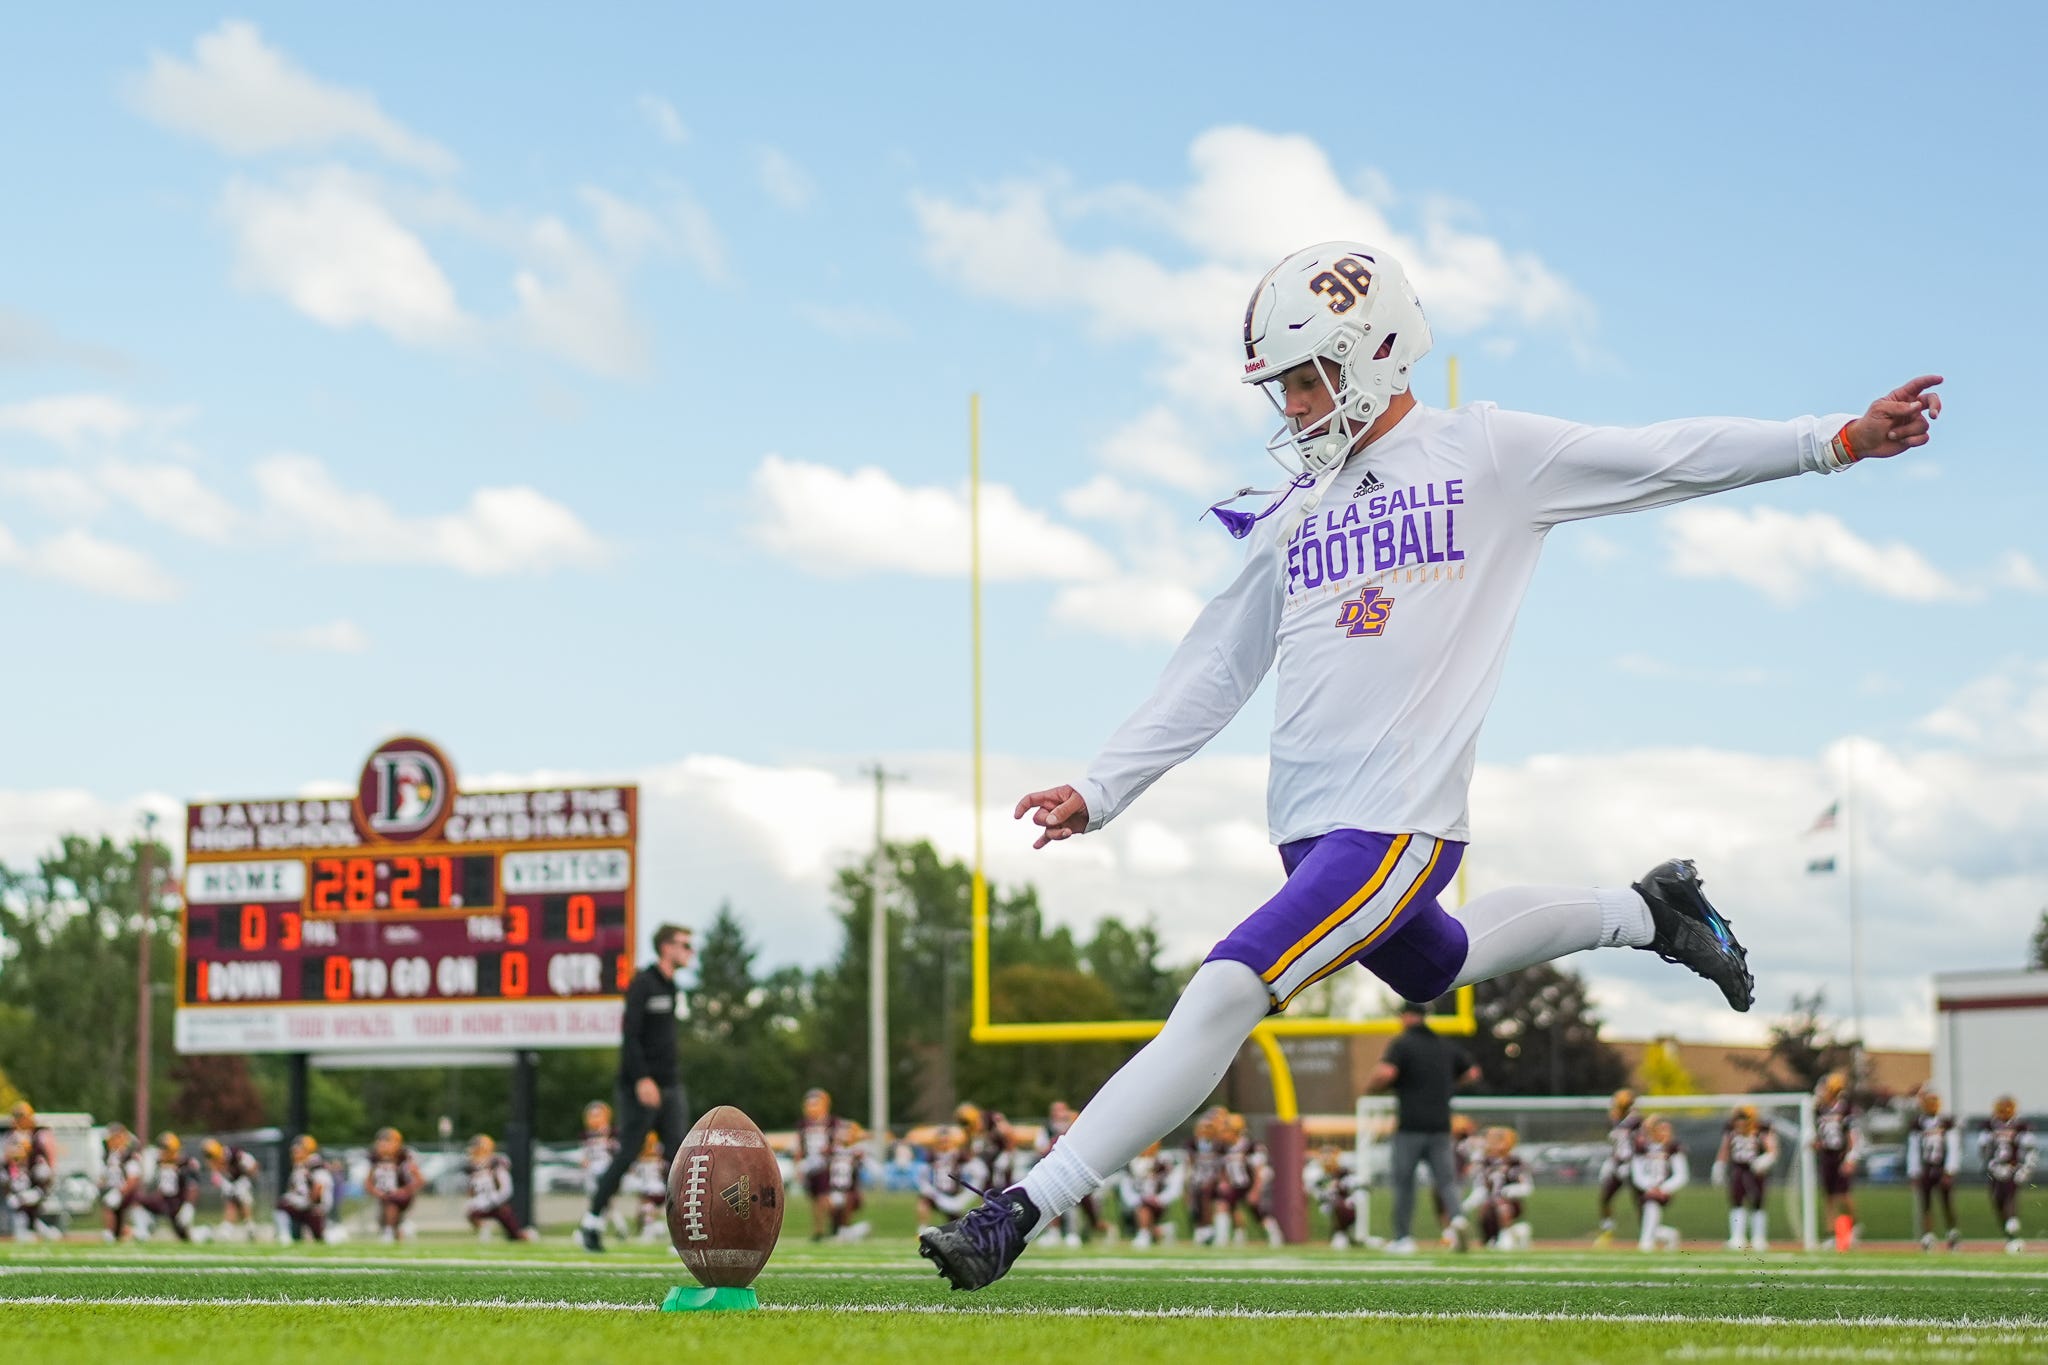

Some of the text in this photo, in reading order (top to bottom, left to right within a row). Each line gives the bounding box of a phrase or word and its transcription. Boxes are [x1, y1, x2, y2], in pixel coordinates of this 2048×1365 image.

[1309, 257, 1373, 315] 38
[1326, 503, 1361, 531] LA
[1368, 479, 1464, 520] SALLE
[1352, 481, 1385, 499] adidas
[1288, 509, 1465, 595] FOOTBALL
[204, 867, 284, 892] HOME
[512, 854, 621, 882] VISITOR
[240, 904, 267, 951] 0
[567, 894, 596, 944] 0
[208, 959, 282, 1000] DOWN
[324, 955, 351, 1002] 0
[351, 955, 478, 999] TO GO ON
[501, 950, 529, 999] 0
[548, 952, 602, 997] QTR
